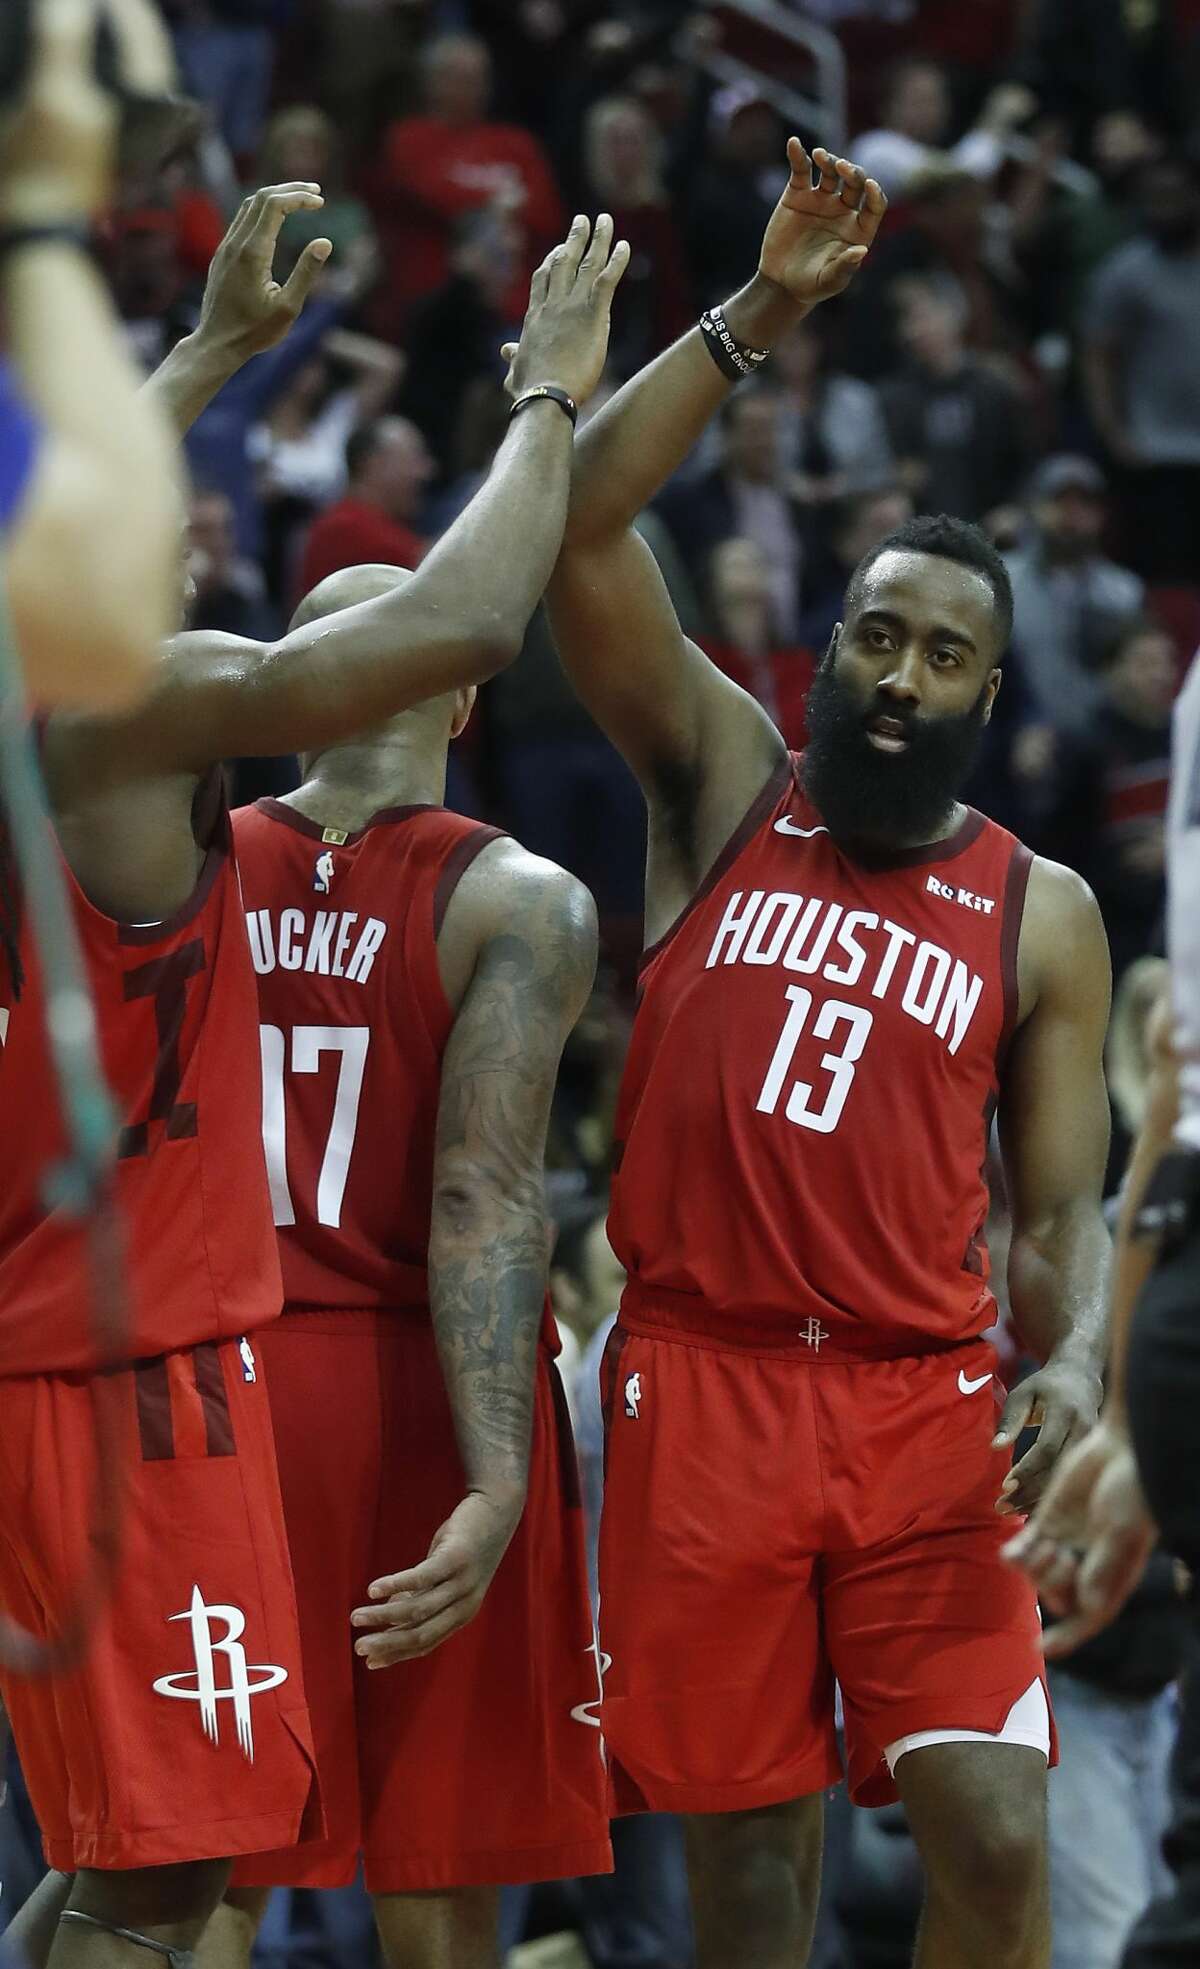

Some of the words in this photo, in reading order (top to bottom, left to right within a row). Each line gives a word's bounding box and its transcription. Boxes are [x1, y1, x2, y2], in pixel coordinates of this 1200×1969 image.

[714, 319, 726, 332] IS
[719, 331, 736, 353] BIG
[730, 352, 752, 373] ENO
[245, 908, 387, 984] UCKER
[705, 890, 984, 1056] HOUSTON
[755, 984, 873, 1134] 13
[259, 1023, 370, 1229] 17
